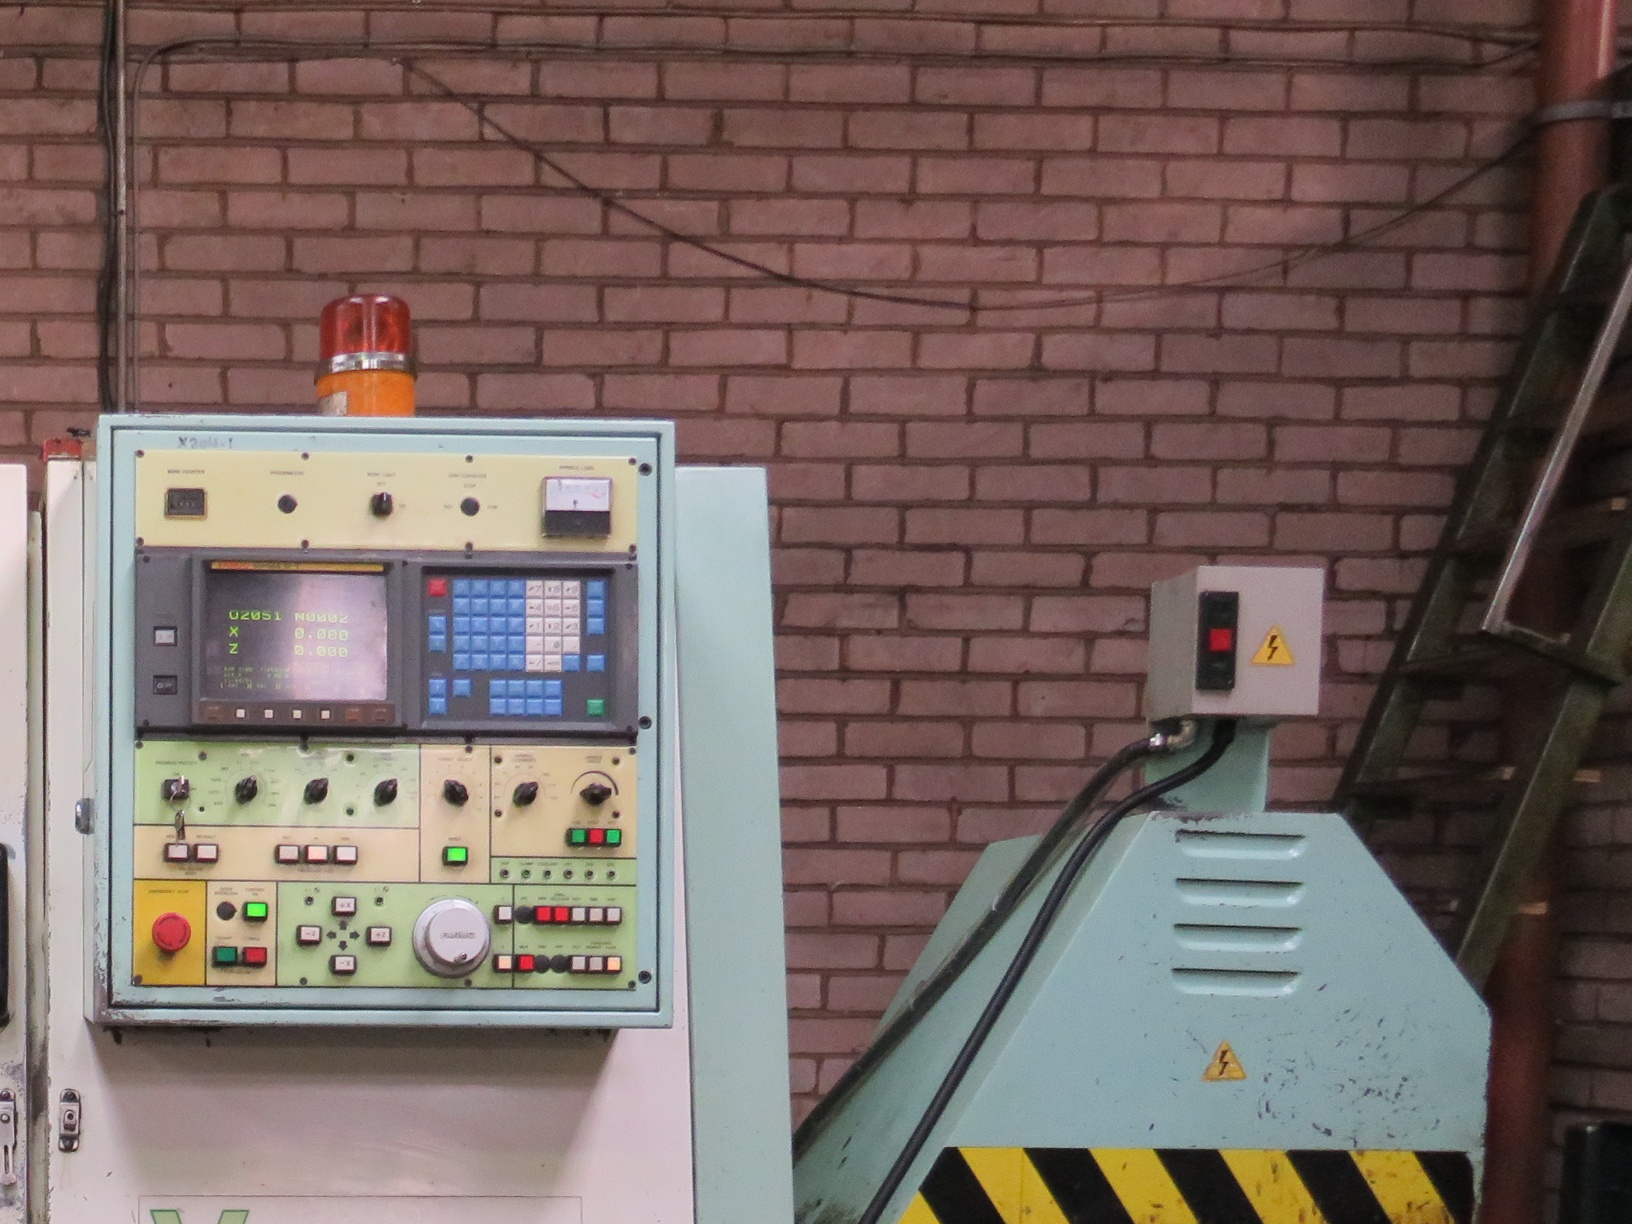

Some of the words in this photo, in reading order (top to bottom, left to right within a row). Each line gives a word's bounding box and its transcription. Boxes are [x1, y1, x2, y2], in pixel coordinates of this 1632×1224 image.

[228, 626, 239, 637] X
[294, 628, 349, 640] 0.000
[228, 643, 239, 654] Z
[294, 644, 349, 657] 0.000
